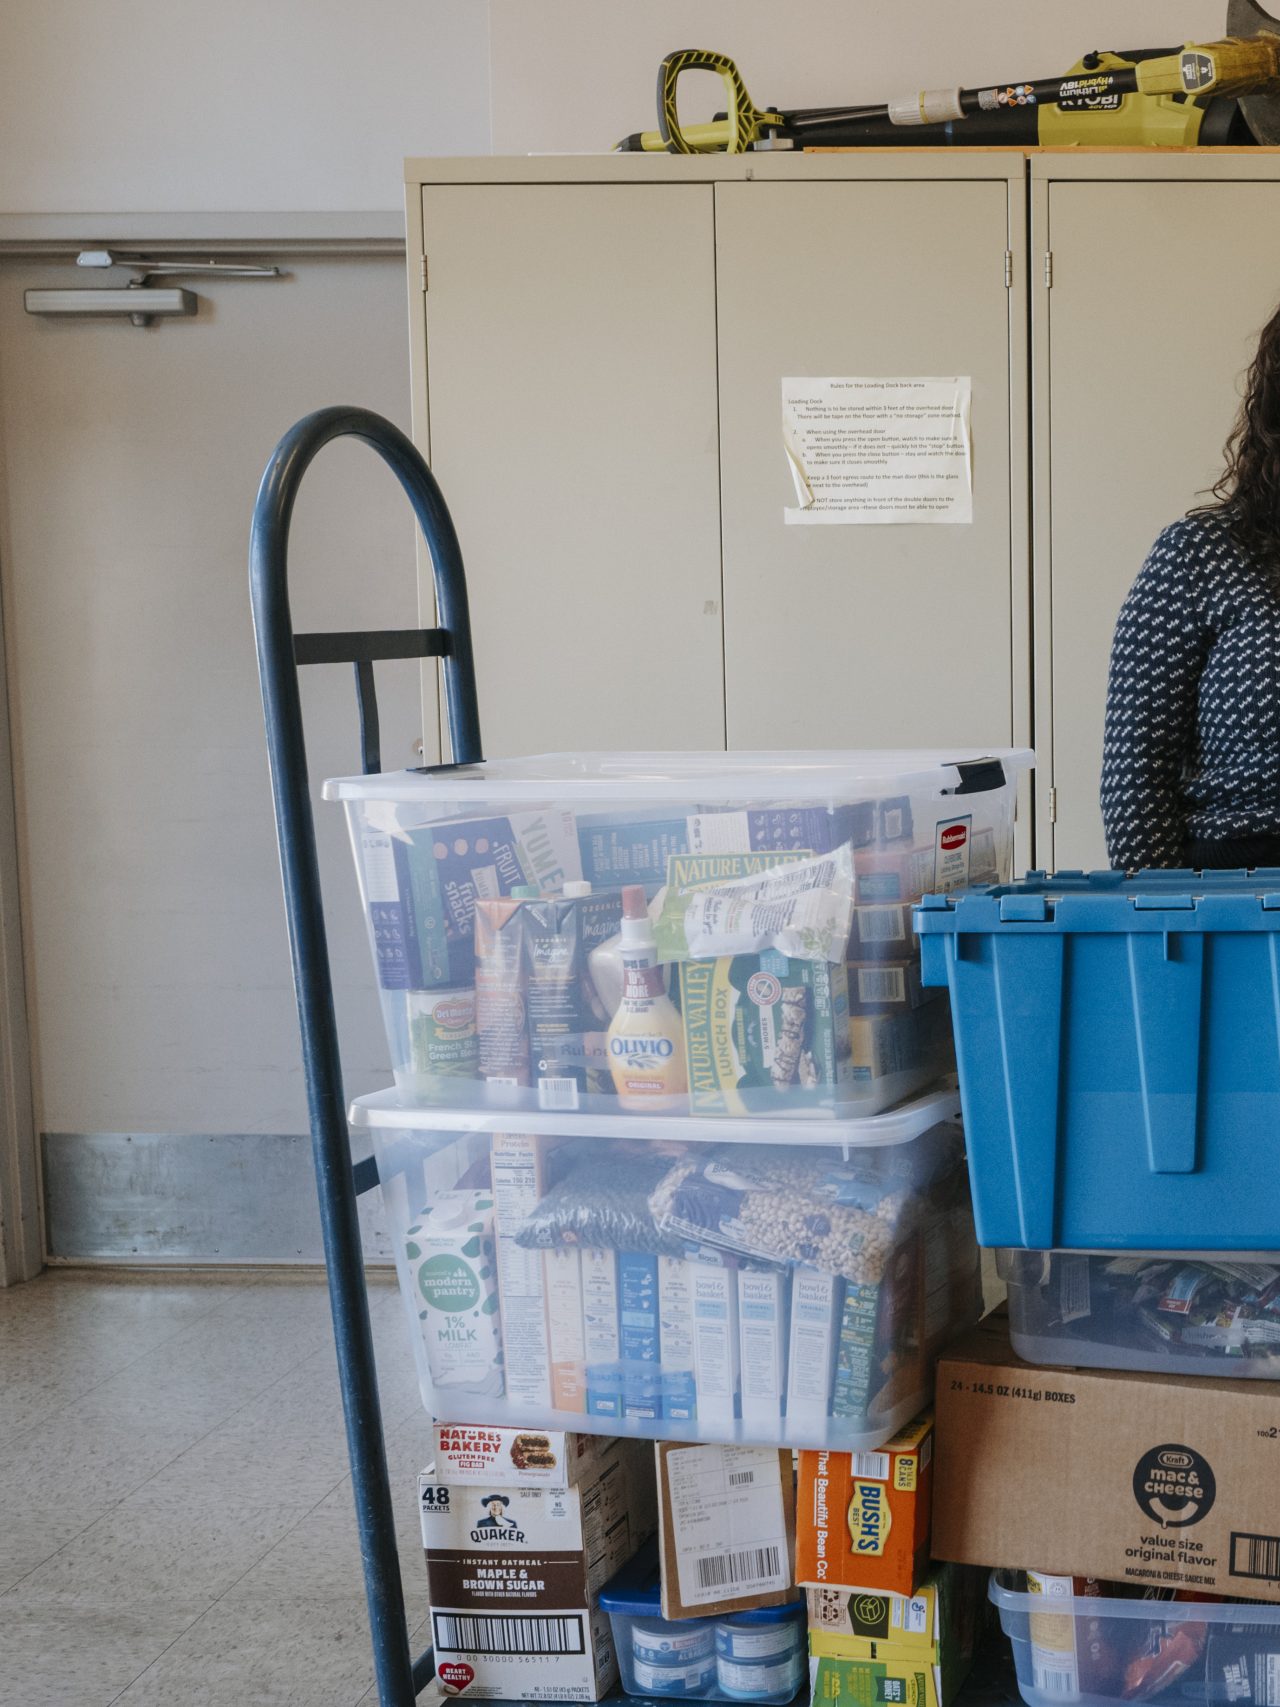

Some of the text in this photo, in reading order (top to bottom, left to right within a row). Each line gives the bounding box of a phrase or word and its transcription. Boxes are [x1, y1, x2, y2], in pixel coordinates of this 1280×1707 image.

[674, 857, 741, 888] NATURE
[444, 880, 472, 936] snacks
[715, 987, 733, 1077] LUNCH BOX
[428, 1042, 462, 1051] French
[610, 1037, 673, 1057] OLIVIO
[429, 1051, 458, 1060] Green
[424, 1276, 473, 1287] modern
[695, 1280, 715, 1290] bowl
[743, 1281, 762, 1291] bowl
[799, 1281, 819, 1292] bowl
[433, 1286, 476, 1298] pantry
[444, 1316, 465, 1329] 1%
[438, 1329, 478, 1341] MILK
[950, 1380, 963, 1391] 24
[972, 1382, 994, 1395] 14.5
[996, 1385, 1009, 1396] OZ
[1044, 1391, 1076, 1404] BOXES
[439, 1440, 502, 1453] BAKERY
[477, 1454, 495, 1462] FREE
[899, 1458, 914, 1466] 8
[1166, 1455, 1186, 1465] Kraft
[1150, 1468, 1200, 1486] mac &
[422, 1487, 450, 1505] 48
[422, 1504, 450, 1512] PACKETS
[817, 1478, 829, 1528] Beautiful
[852, 1507, 860, 1526] BEST
[857, 1485, 881, 1551] BUSH'S
[470, 1528, 525, 1544] QUAKER
[817, 1530, 828, 1558] Bean
[1140, 1534, 1204, 1552] value size
[1125, 1546, 1218, 1567] original flavor
[477, 1568, 528, 1579] MAPLE &
[1125, 1567, 1216, 1585] MACARONI & CHEESE SAUCE MIX
[462, 1579, 545, 1590] BROWN SUGAR
[442, 1673, 470, 1681] HEALTHY
